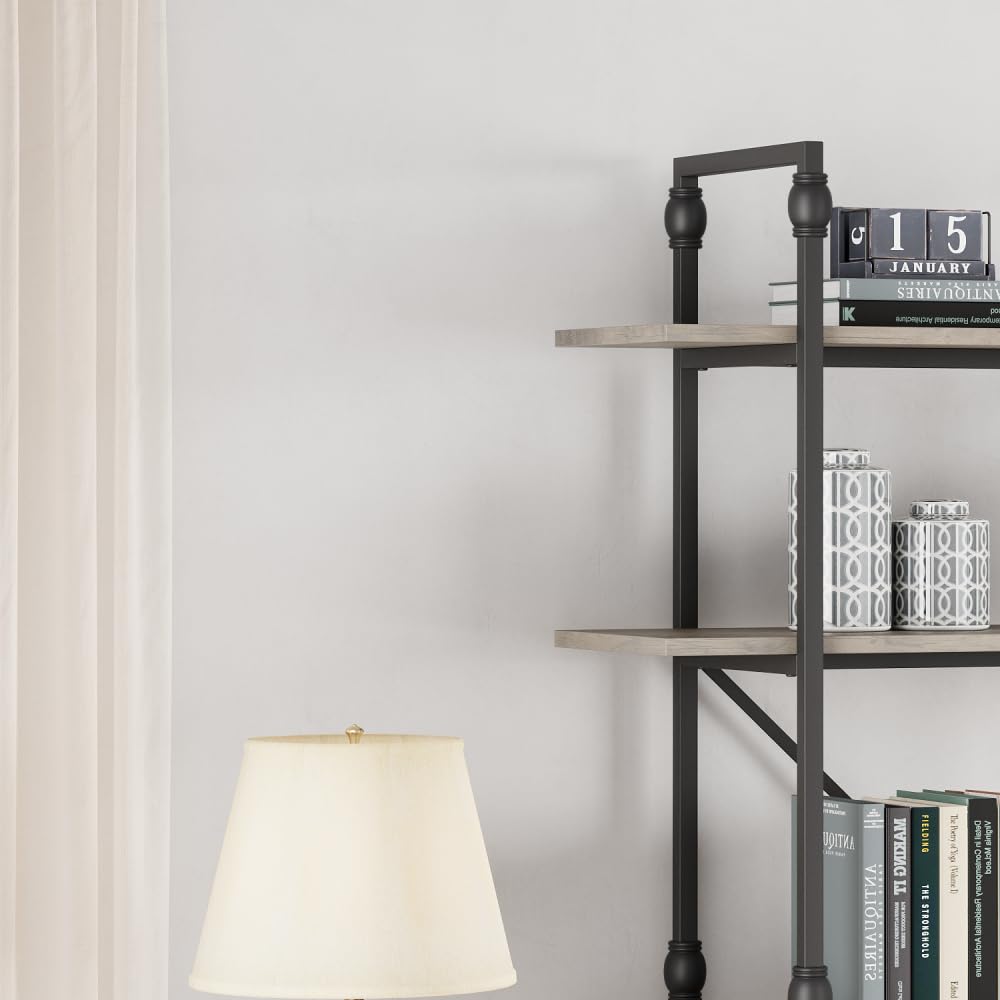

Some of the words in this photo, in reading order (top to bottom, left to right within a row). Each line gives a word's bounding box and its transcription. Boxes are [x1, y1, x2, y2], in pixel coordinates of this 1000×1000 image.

[889, 212, 904, 251] 1
[947, 215, 967, 253] 5
[889, 262, 972, 274] JANUARY
[896, 316, 933, 324] Architecture
[934, 316, 968, 325] Residential
[950, 814, 958, 824] The
[948, 826, 958, 842] Poetry
[948, 850, 958, 862] Yoga
[950, 981, 958, 998] Edited
